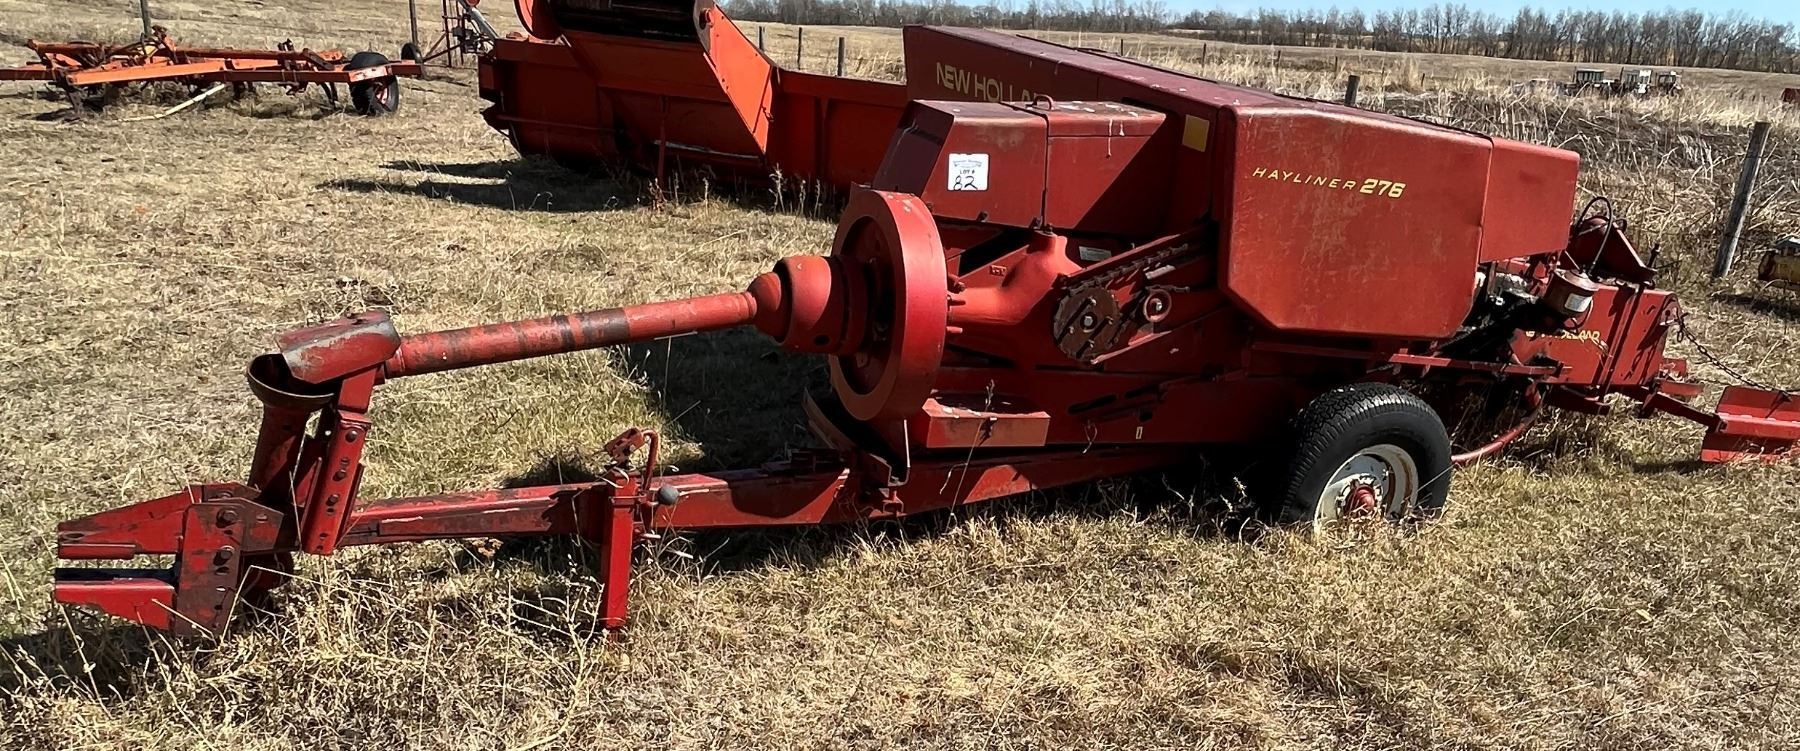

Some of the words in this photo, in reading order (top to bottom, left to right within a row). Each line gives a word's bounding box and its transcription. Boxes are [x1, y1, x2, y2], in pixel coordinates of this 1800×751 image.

[936, 62, 970, 94] NEW
[953, 174, 979, 191] 82
[1252, 167, 1356, 190] HAYLINER
[1359, 178, 1406, 198] 276
